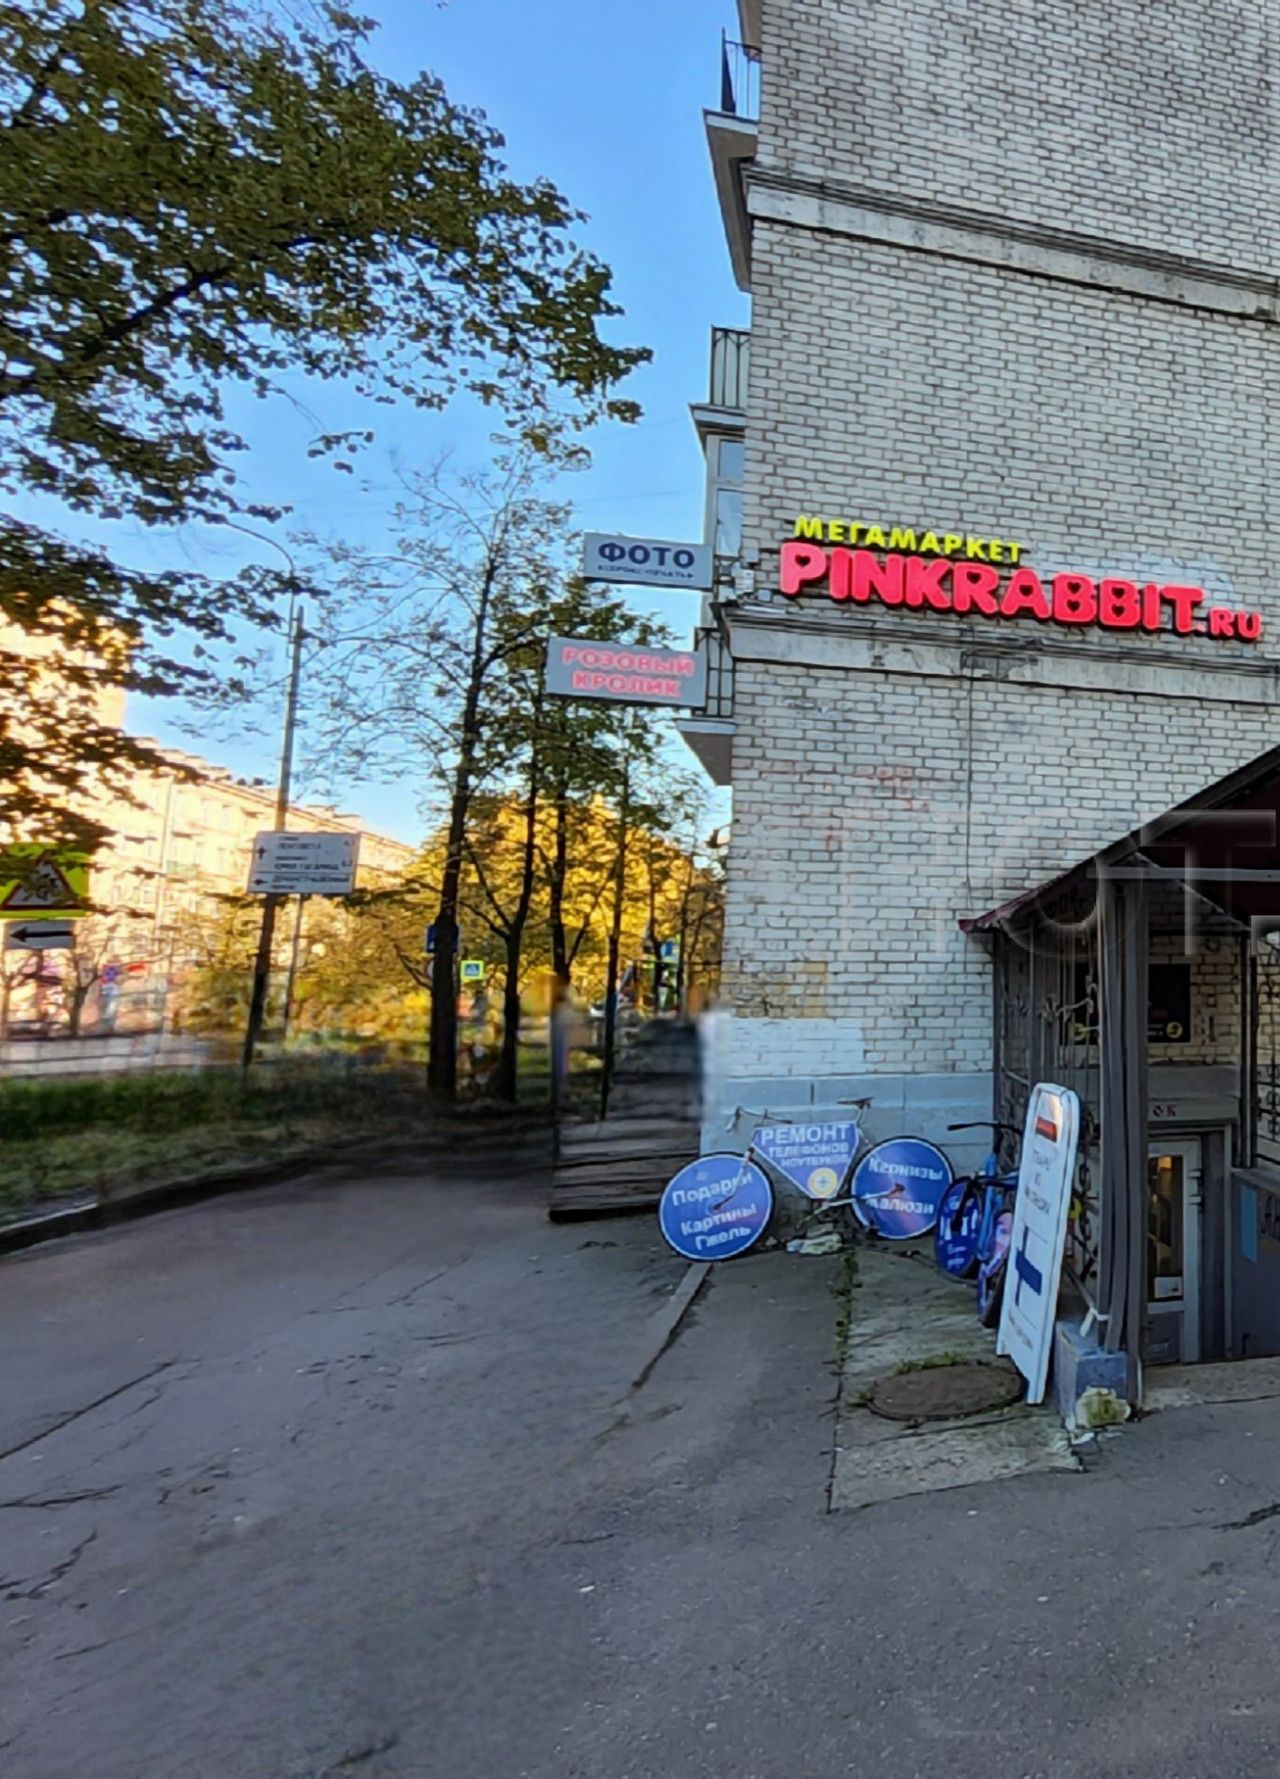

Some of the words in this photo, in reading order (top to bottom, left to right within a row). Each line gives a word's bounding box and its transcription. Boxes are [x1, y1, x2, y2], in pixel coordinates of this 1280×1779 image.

[794, 515, 1022, 563] МЕГАМАРКЕТ
[598, 542, 694, 569] ФОТО
[562, 647, 694, 676] РОЗОВЫЙ
[572, 670, 681, 697] КРОЛИК
[761, 1124, 850, 1146] РЕМОНТ
[869, 1157, 943, 1180] Карнизы
[672, 1172, 752, 1206] Подарки
[681, 1203, 757, 1236] Картины
[695, 1227, 751, 1250] Гжель
